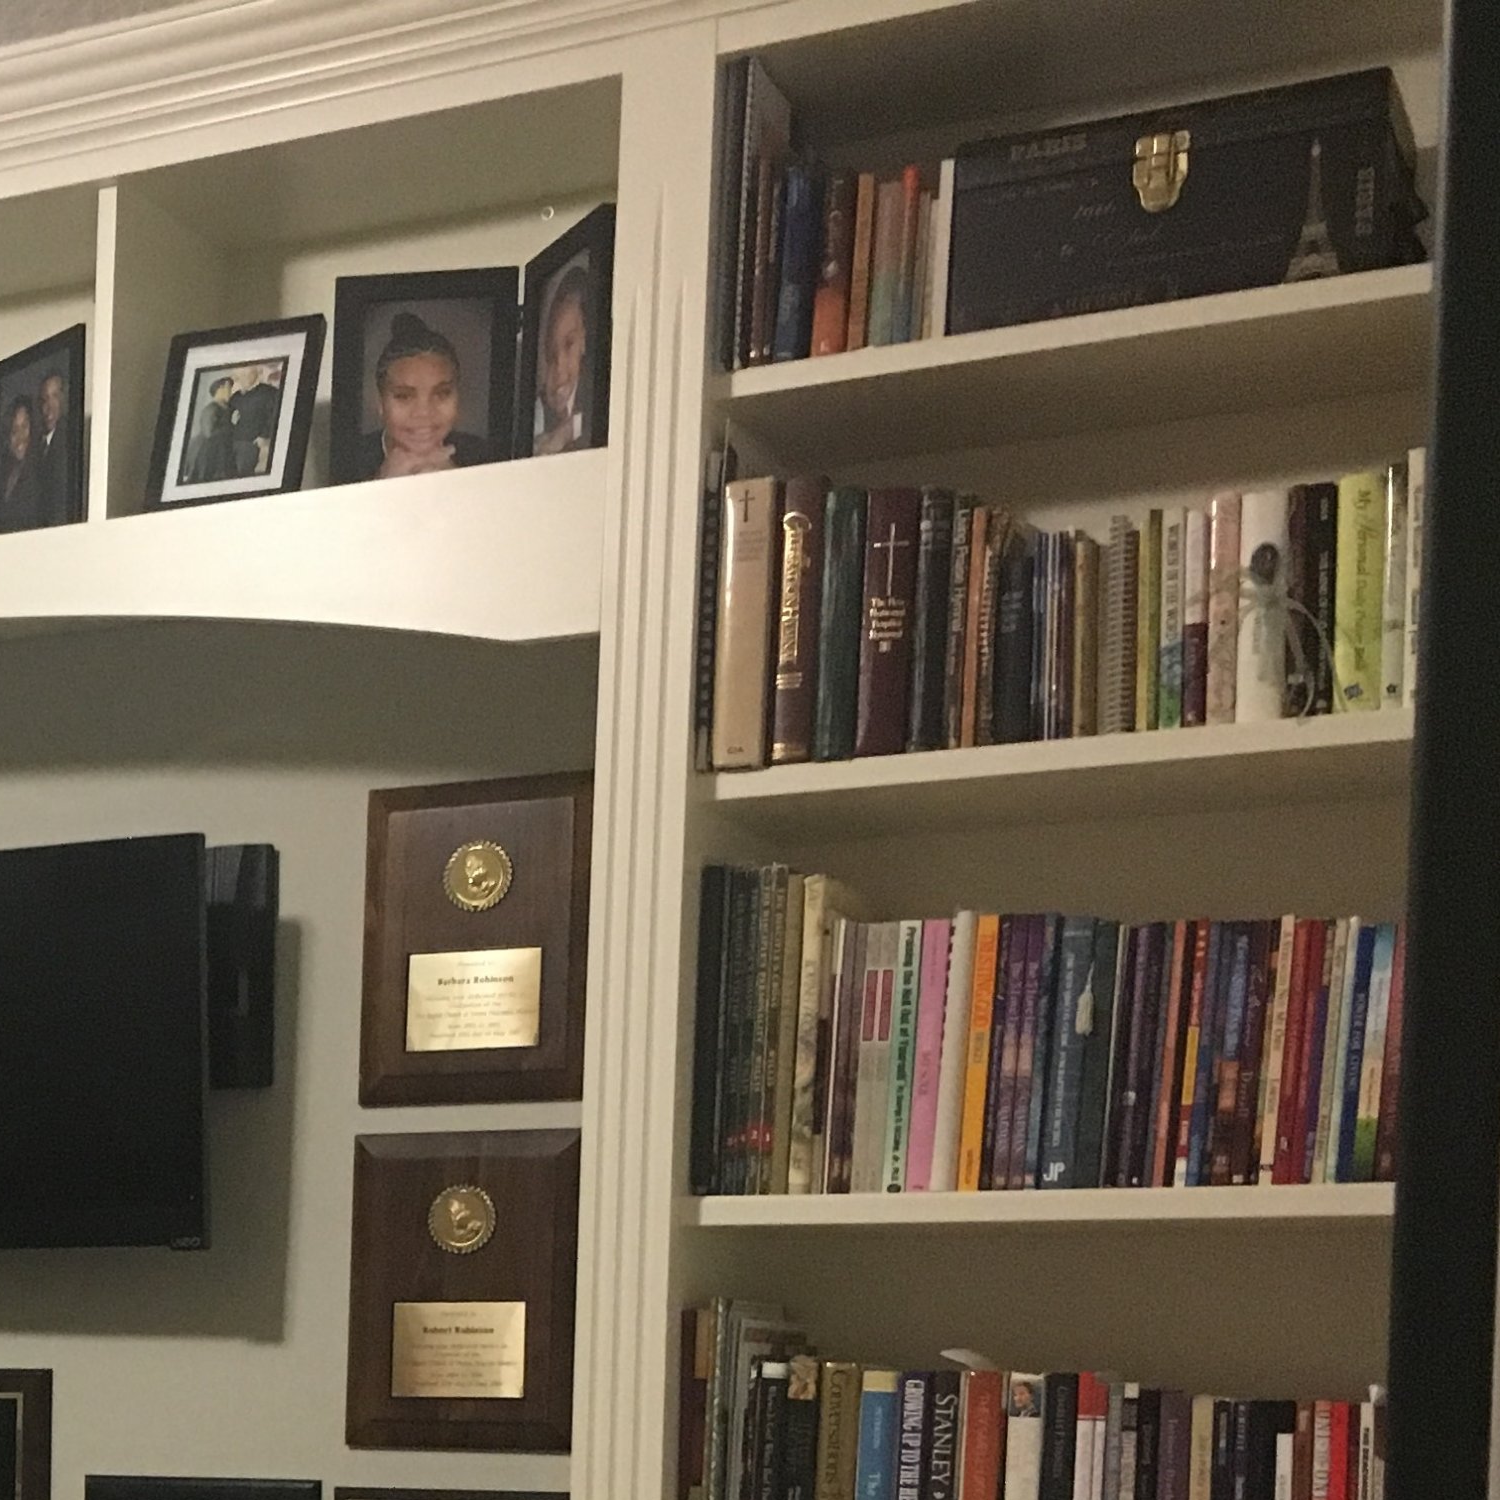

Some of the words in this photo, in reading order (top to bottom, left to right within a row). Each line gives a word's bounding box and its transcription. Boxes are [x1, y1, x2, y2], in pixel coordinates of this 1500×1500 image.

[473, 974, 514, 984] Robinson
[901, 1379, 925, 1430] GROWING
[824, 1369, 847, 1485] Conversations
[901, 1431, 923, 1447] UP
[931, 1393, 958, 1485] STANLEY
[900, 1447, 922, 1463] TO
[867, 1471, 882, 1497] The
[898, 1464, 921, 1485] THE
